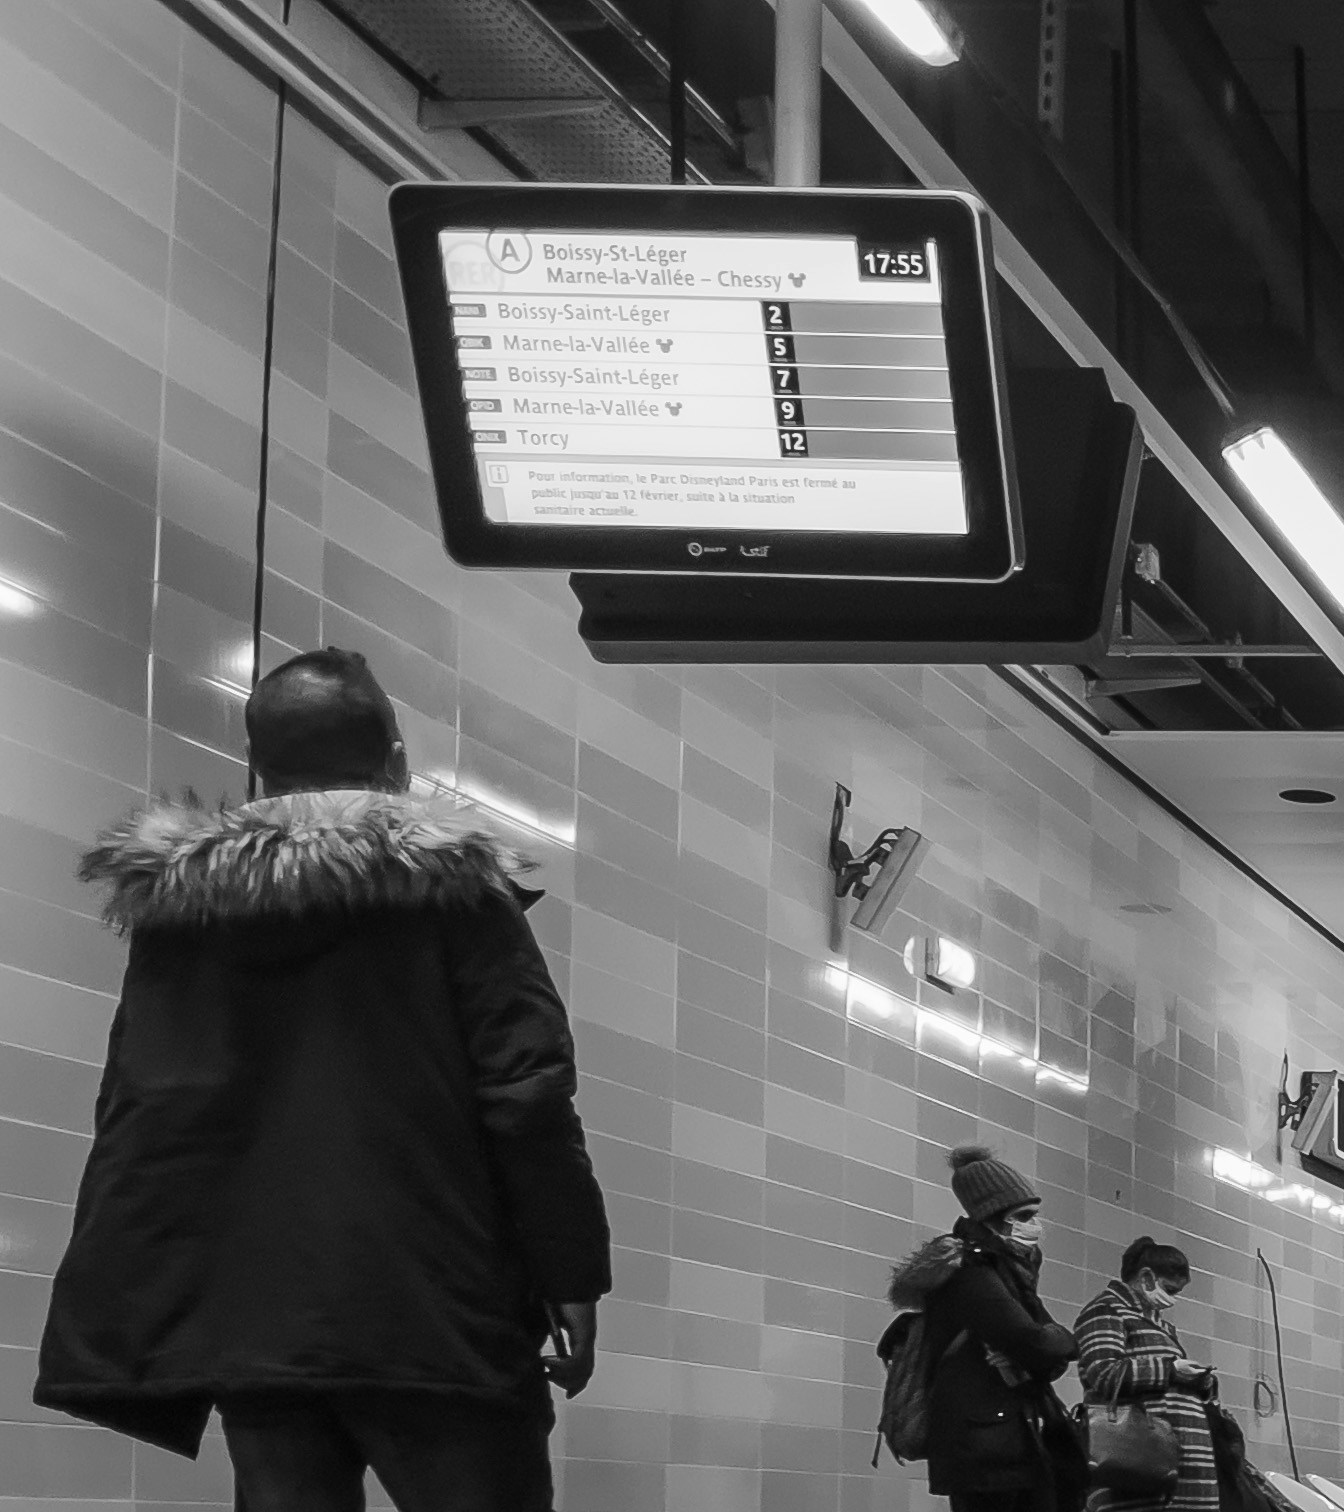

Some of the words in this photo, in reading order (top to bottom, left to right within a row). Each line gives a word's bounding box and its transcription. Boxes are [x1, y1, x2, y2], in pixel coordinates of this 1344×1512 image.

[500, 238, 521, 262] A
[543, 243, 687, 266] Boissy-St-Léger
[863, 253, 924, 275] 17:55
[546, 267, 696, 287] Marne-la-Vallée
[717, 270, 782, 293] Chessy
[498, 303, 671, 326] Boissy-Saint-Léger
[768, 305, 783, 324] 2
[503, 334, 651, 354] Marne-la-Vallée
[773, 337, 787, 356] 5
[508, 366, 680, 390] Boissy-Saint-Léger
[776, 369, 791, 388] 7
[512, 398, 660, 417] Marne-la-Vallée
[781, 401, 795, 420] 9
[516, 429, 570, 450] Torcy
[780, 432, 806, 451] 12
[528, 470, 555, 482] Pour
[559, 471, 634, 485] information,
[636, 472, 647, 484] le
[650, 473, 677, 485] Parc
[680, 474, 745, 487] Disneyland
[748, 475, 778, 487] Paris
[781, 477, 800, 488] est
[803, 477, 838, 489] fermé
[842, 479, 856, 489] au
[531, 488, 567, 500] public
[623, 489, 637, 500] 12
[640, 489, 683, 502] février,
[686, 491, 715, 502] suite
[718, 491, 726, 502] à
[729, 492, 739, 503] la
[743, 493, 796, 504] situation
[534, 505, 585, 516] sanitaire
[588, 505, 638, 517] actuelle.
